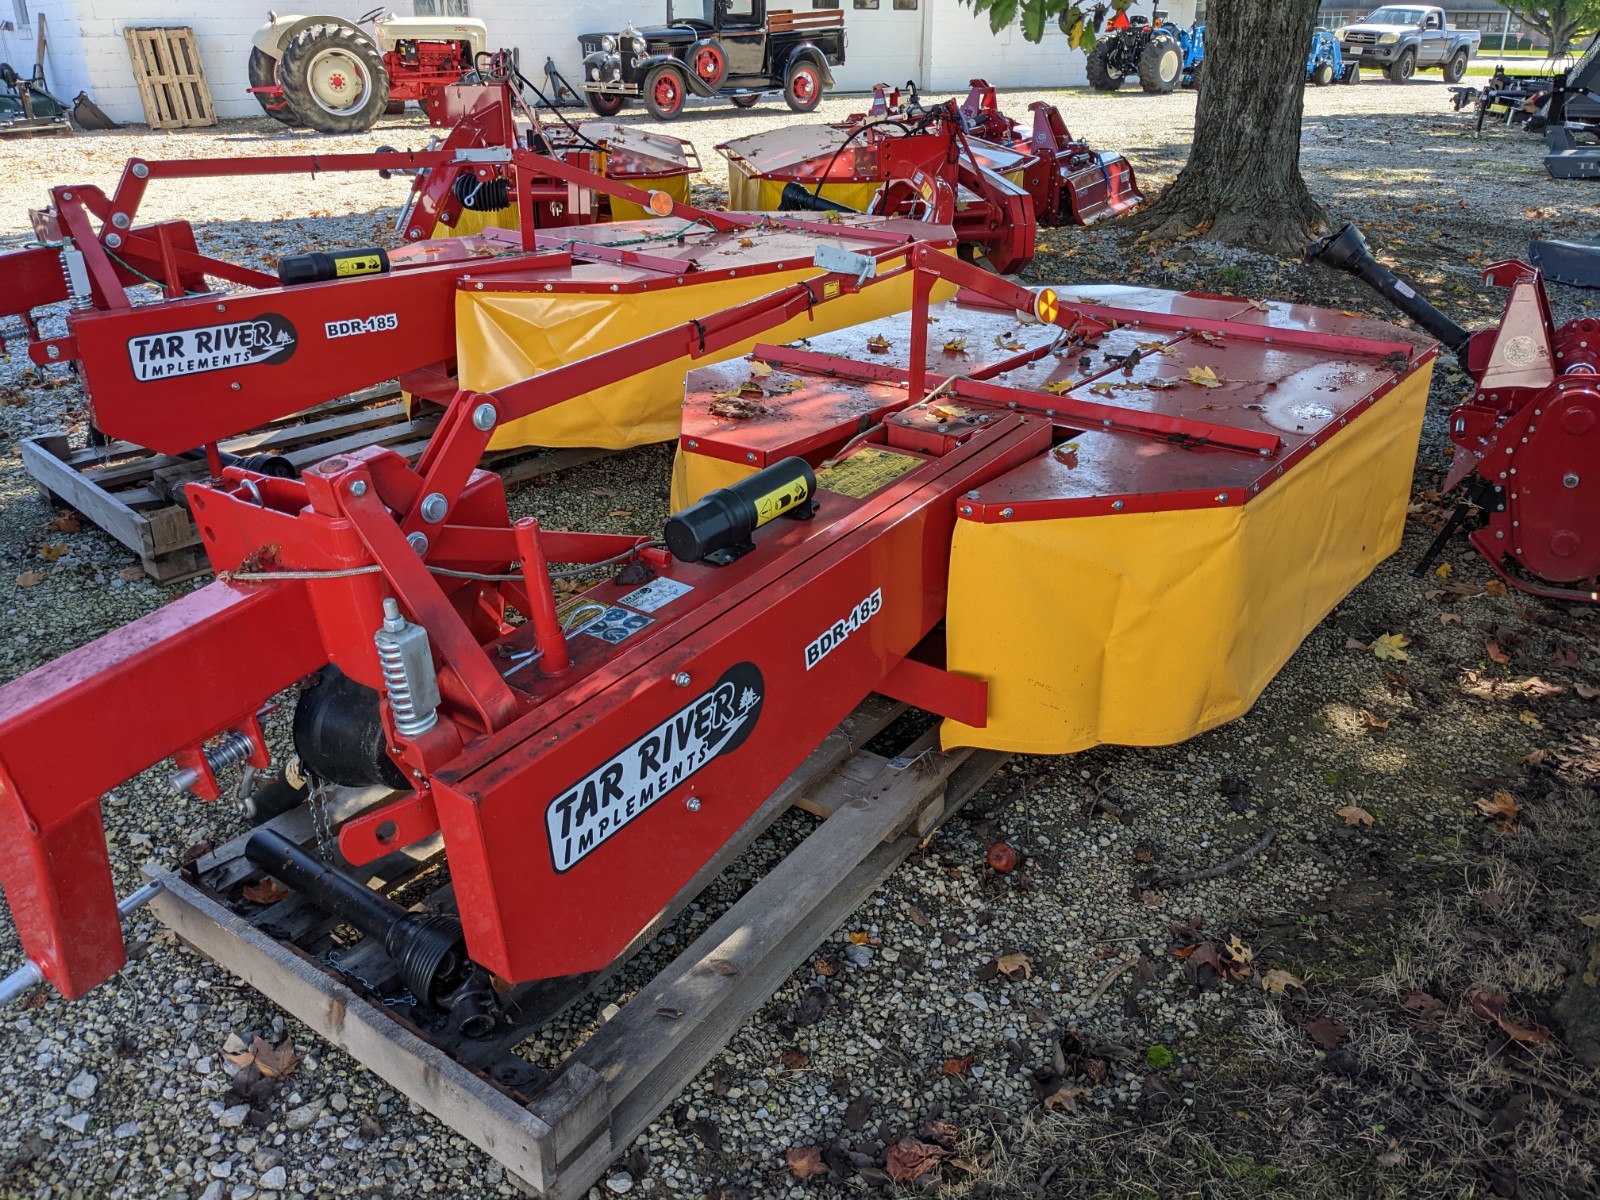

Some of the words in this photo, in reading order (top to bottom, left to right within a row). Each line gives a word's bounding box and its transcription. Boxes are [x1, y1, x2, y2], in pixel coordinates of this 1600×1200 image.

[134, 335, 186, 363] TAR
[195, 322, 273, 354] RIVER
[327, 315, 396, 337] BDR-185
[142, 351, 250, 378] IMPLEMENTS
[807, 591, 880, 666] BDR-185
[555, 762, 624, 839] TAR
[637, 684, 735, 780] RIVER
[564, 742, 708, 865] IMPLEMENTS
